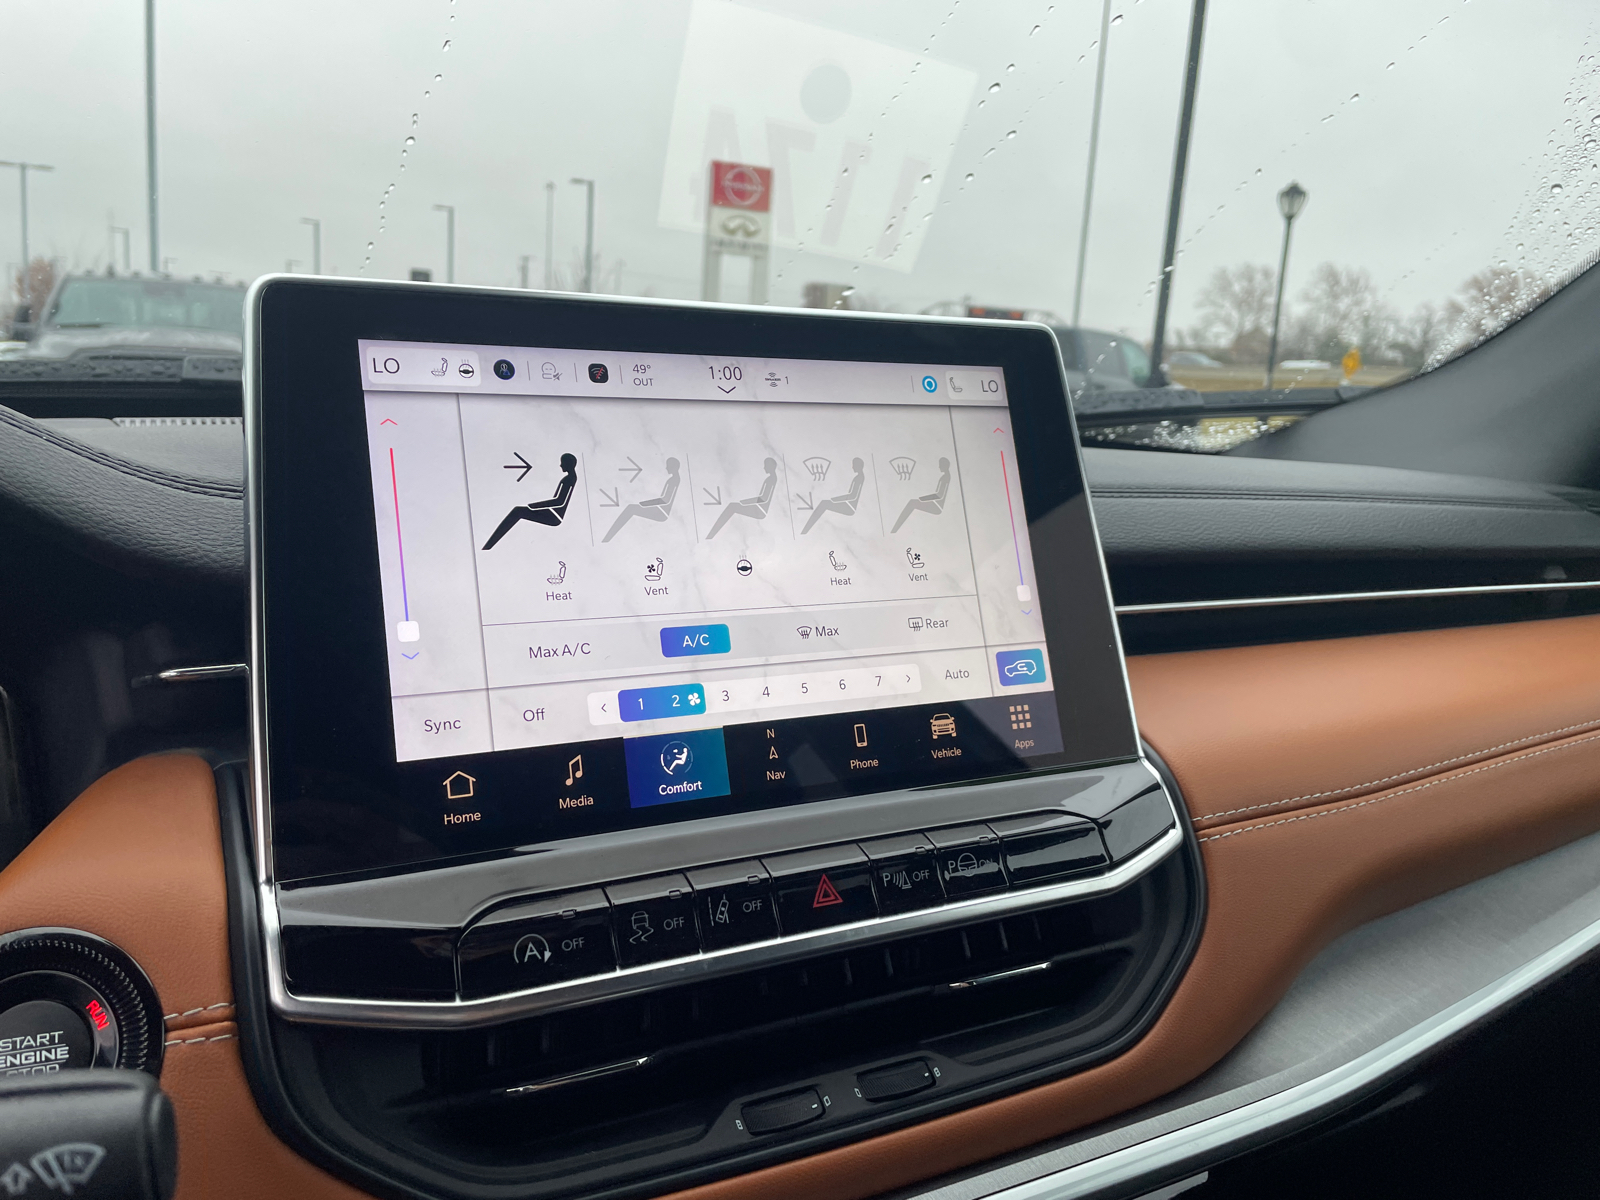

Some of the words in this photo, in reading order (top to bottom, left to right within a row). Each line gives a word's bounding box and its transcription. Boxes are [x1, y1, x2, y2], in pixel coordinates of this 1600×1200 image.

[372, 357, 400, 374] LO
[632, 364, 652, 374] 49°
[708, 366, 743, 381] 1:00
[784, 375, 789, 385] 1
[632, 377, 654, 387] OUT
[980, 379, 999, 393] LO
[829, 576, 852, 586] Heat
[908, 572, 929, 582] Vent
[545, 590, 573, 602] Heat
[644, 585, 669, 596] Vent
[925, 618, 949, 630] Rear
[814, 625, 840, 638] Max
[682, 633, 710, 648] A/C
[528, 645, 559, 659] Max
[561, 642, 592, 657] A/C
[944, 668, 970, 680] Auto
[637, 698, 644, 711] 1
[671, 694, 681, 708] 2
[721, 690, 730, 702] 3
[762, 686, 771, 698] 4
[801, 682, 809, 694] 5
[838, 679, 847, 691] 6
[874, 675, 882, 687] 7
[522, 707, 546, 722] Off
[424, 718, 462, 734] Sync
[766, 728, 775, 739] N
[1014, 738, 1035, 749] Apps
[931, 746, 962, 759] Vehicle
[850, 757, 879, 770] Phone
[766, 770, 786, 781] Nav
[658, 779, 703, 796] Comfort
[559, 794, 594, 809] Media
[443, 810, 482, 825] Home
[882, 872, 892, 887] P
[912, 869, 930, 882] OFF
[742, 899, 763, 913] OFF
[663, 916, 686, 931] OFF
[561, 936, 586, 951] OFF
[86, 1000, 110, 1031] RUN
[0, 1030, 64, 1052] START
